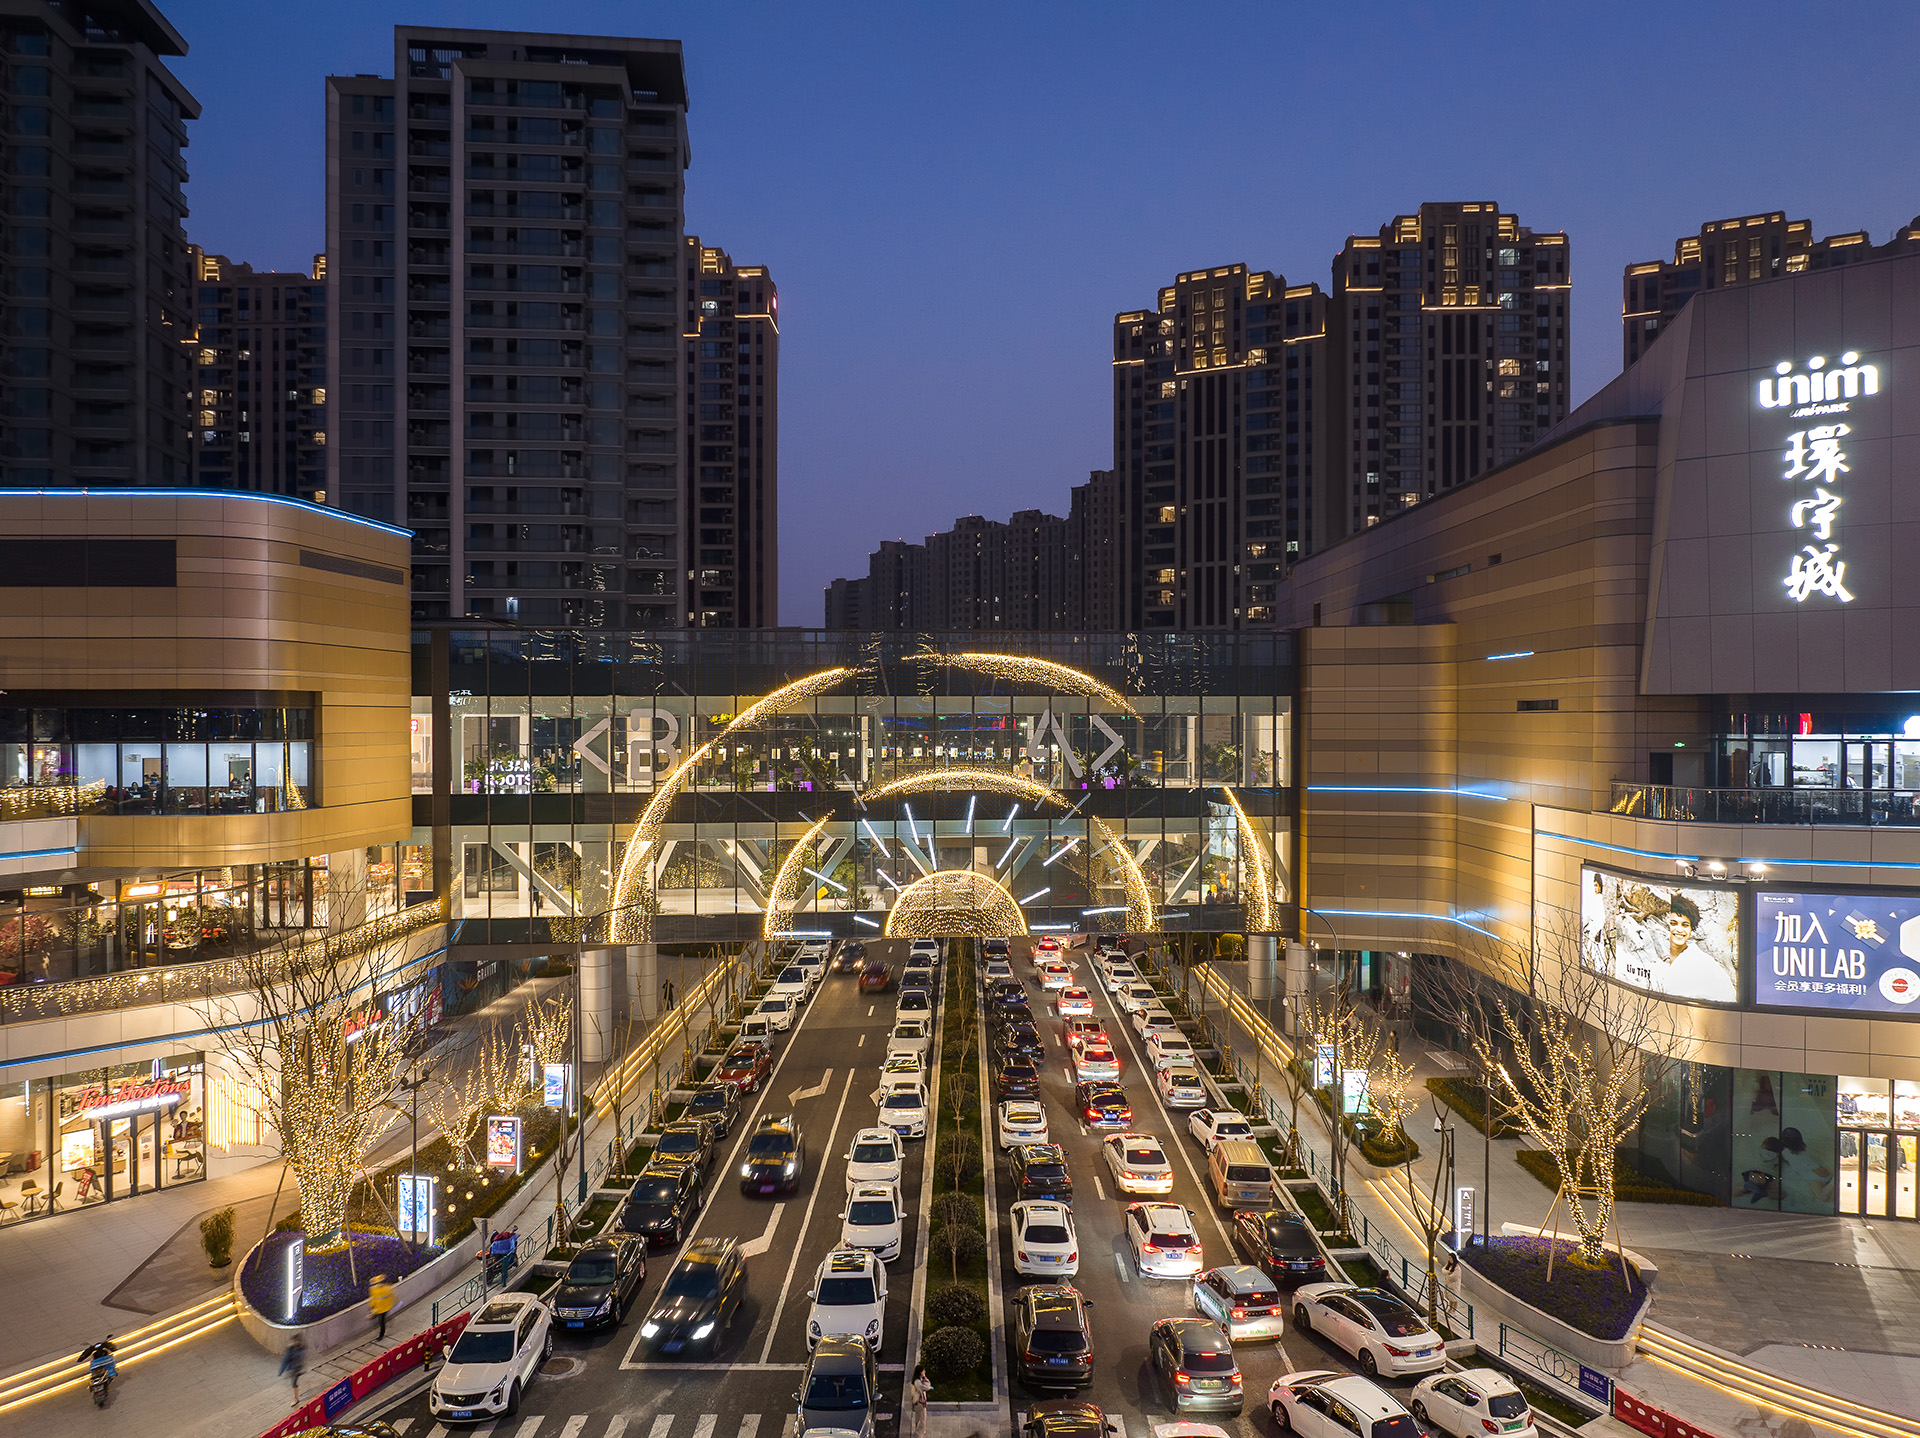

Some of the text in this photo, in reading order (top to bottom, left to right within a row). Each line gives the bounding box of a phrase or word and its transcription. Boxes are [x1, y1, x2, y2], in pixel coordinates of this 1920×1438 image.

[1773, 911, 1829, 944] 加入
[477, 962, 497, 982] GRAVITY
[1773, 946, 1866, 980] UNI LAB
[77, 1086, 113, 1111] Tim
[115, 1078, 191, 1103] Hortons
